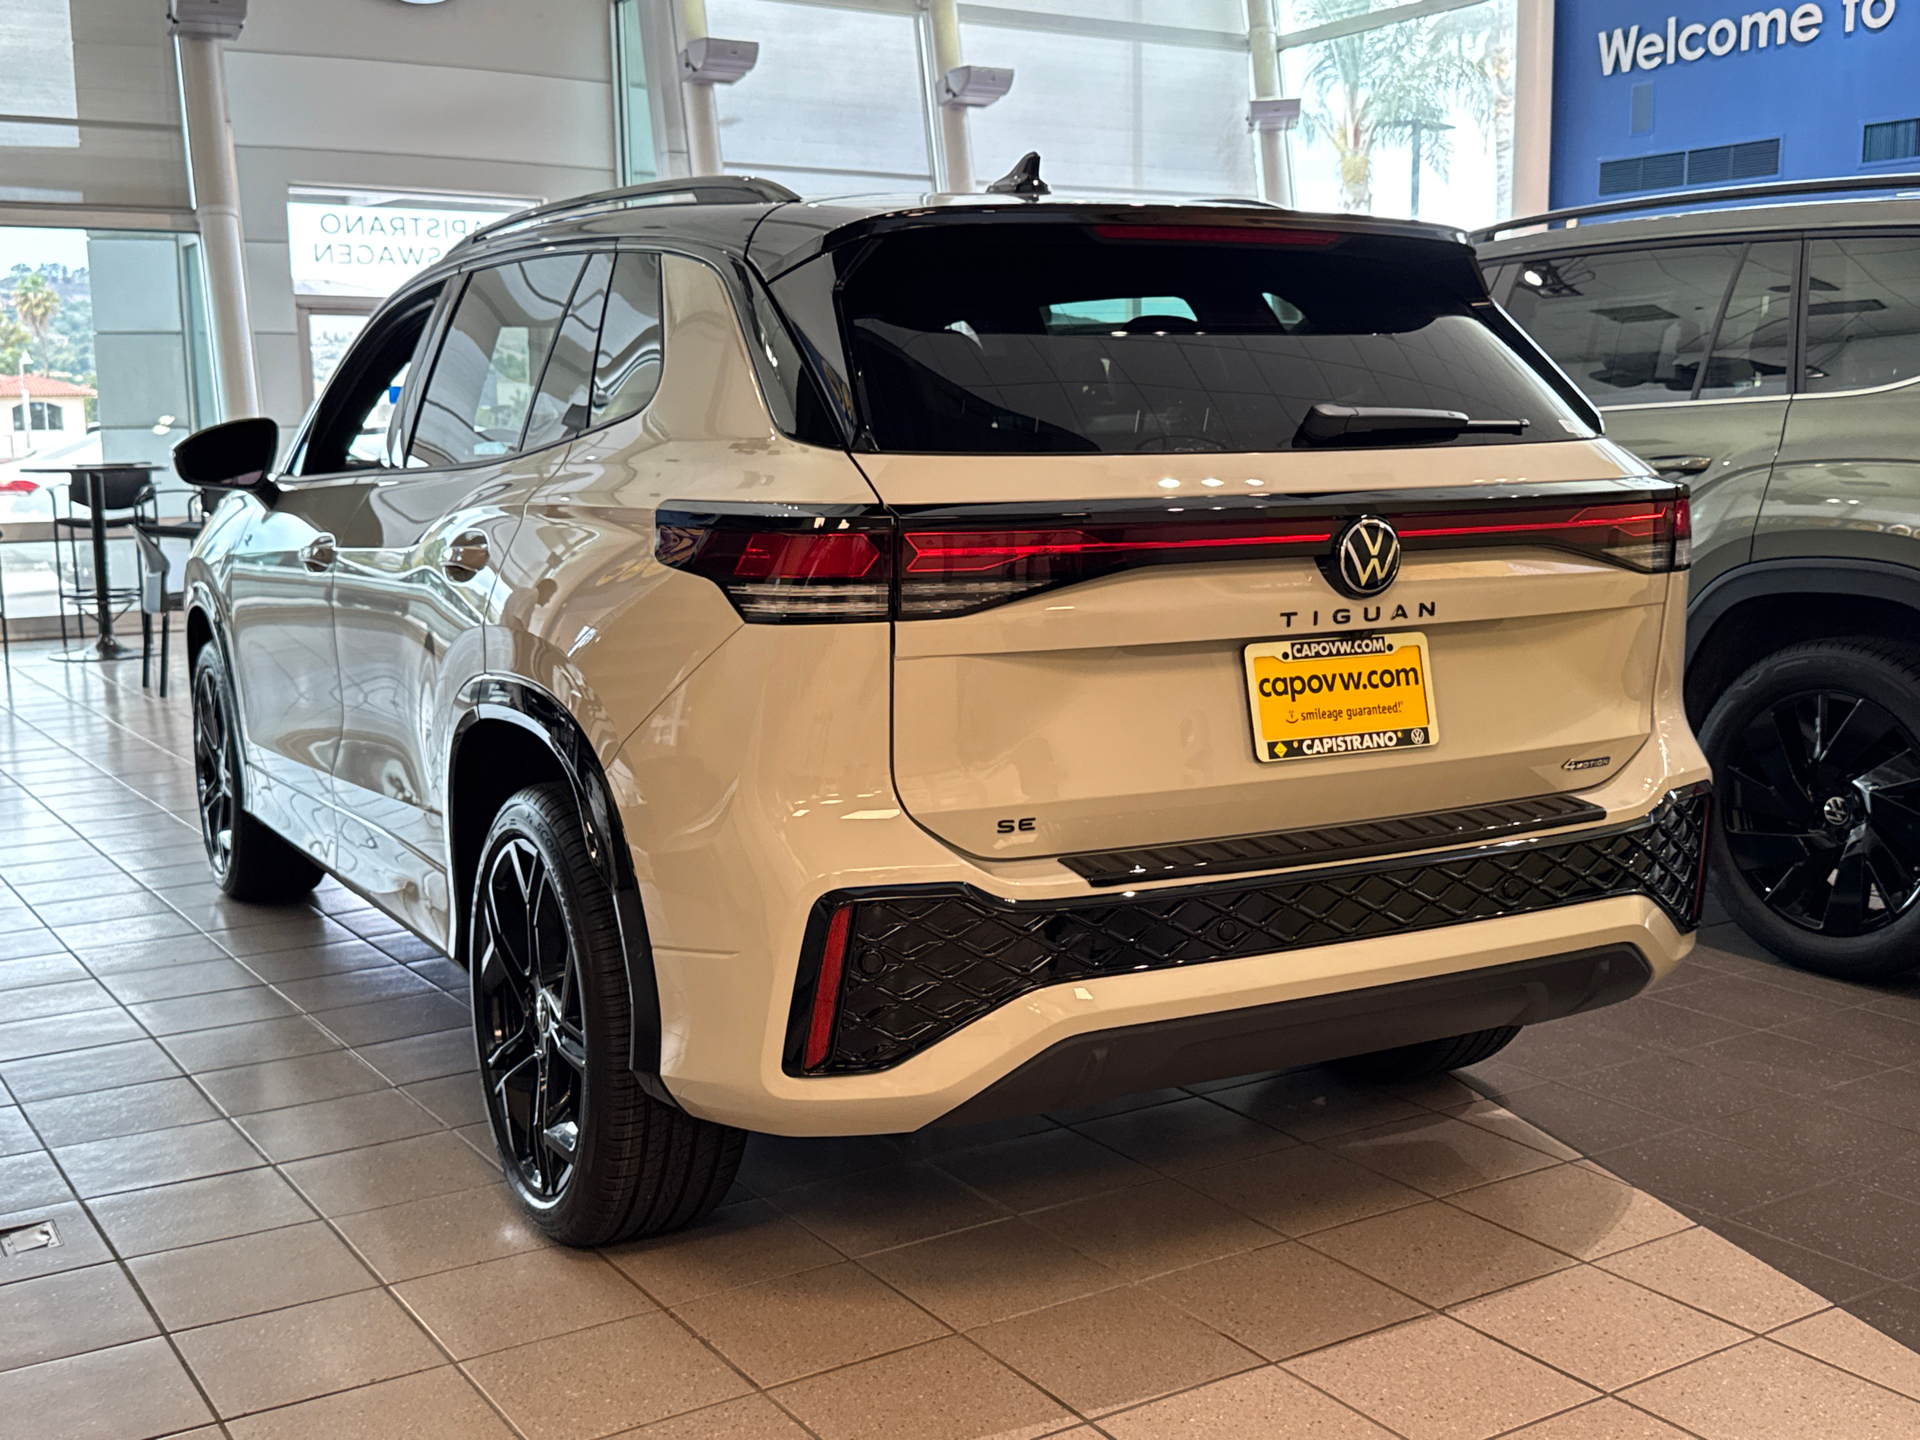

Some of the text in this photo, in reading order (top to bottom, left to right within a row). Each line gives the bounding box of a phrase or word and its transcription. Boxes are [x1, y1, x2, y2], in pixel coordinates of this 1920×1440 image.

[1598, 0, 1896, 77] Welcome to
[1280, 601, 1436, 628] TIGUAN
[1292, 637, 1385, 658] CAPOVW.COM
[1258, 666, 1420, 702] capovw.com
[1300, 708, 1343, 721] smileage
[1302, 730, 1397, 755] CAPISTRANO
[996, 817, 1036, 834] SE
